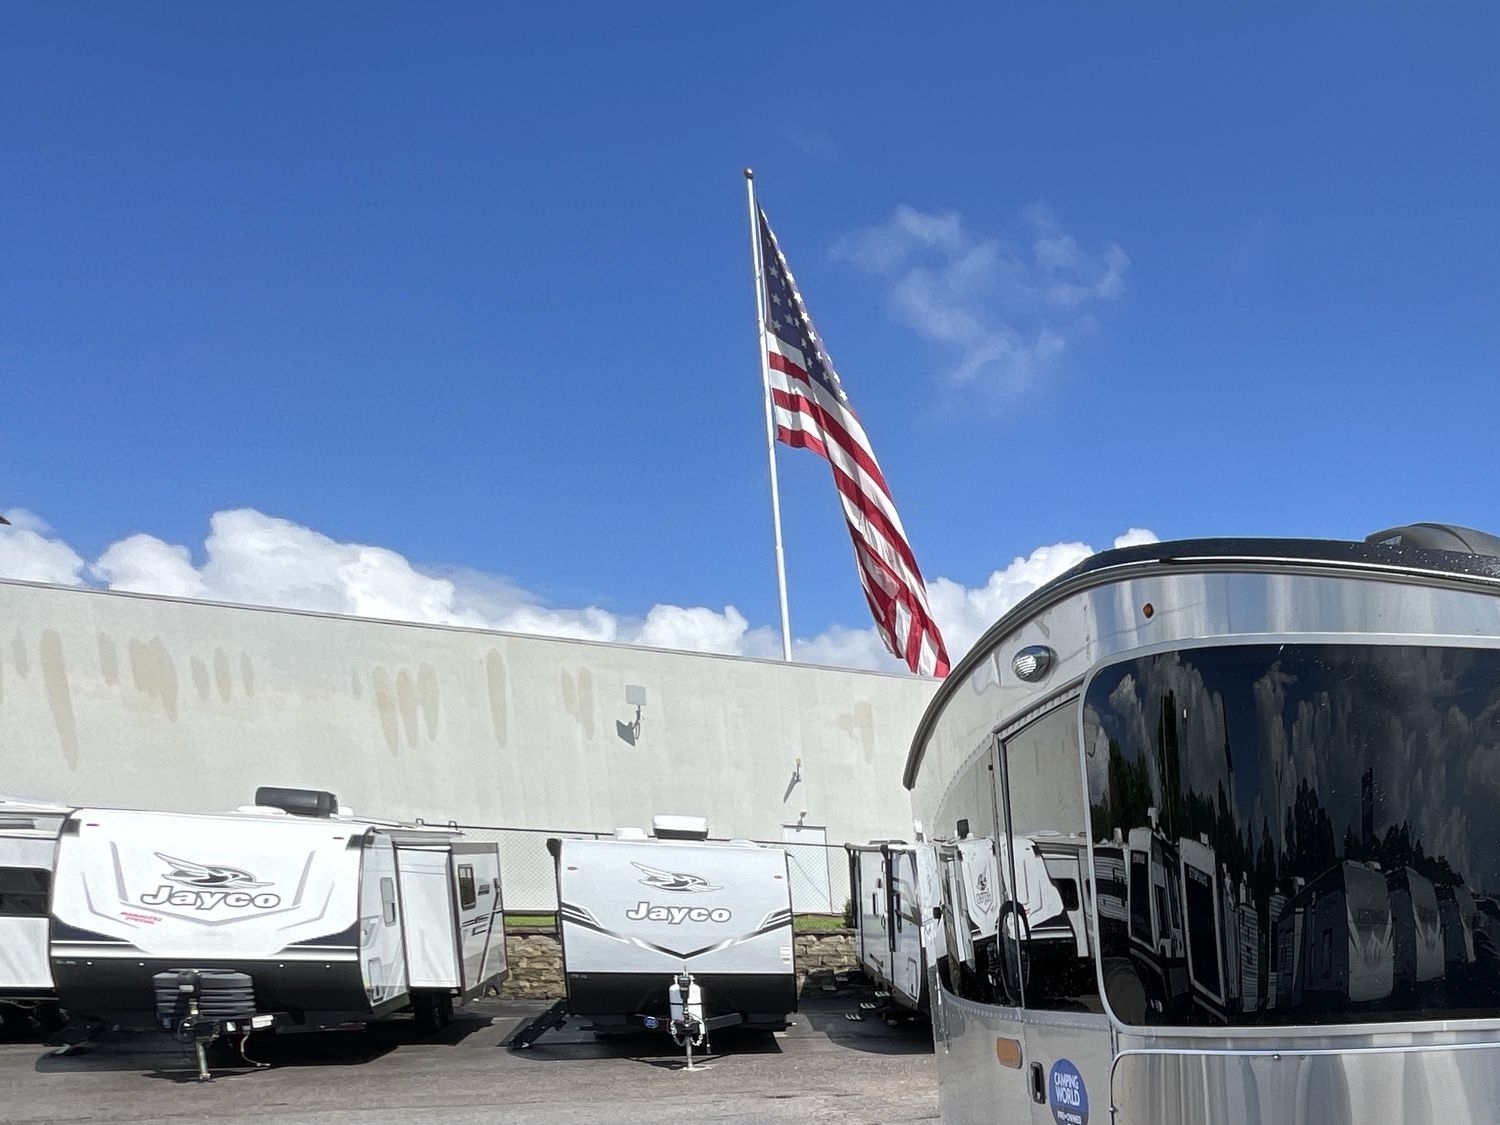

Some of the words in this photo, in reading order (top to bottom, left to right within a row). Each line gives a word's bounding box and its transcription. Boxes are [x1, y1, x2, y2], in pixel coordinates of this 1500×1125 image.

[140, 885, 281, 910] Jayco
[626, 901, 732, 925] Jayco
[1053, 1072, 1079, 1090] CAMPING
[1055, 1086, 1080, 1106] WORLD
